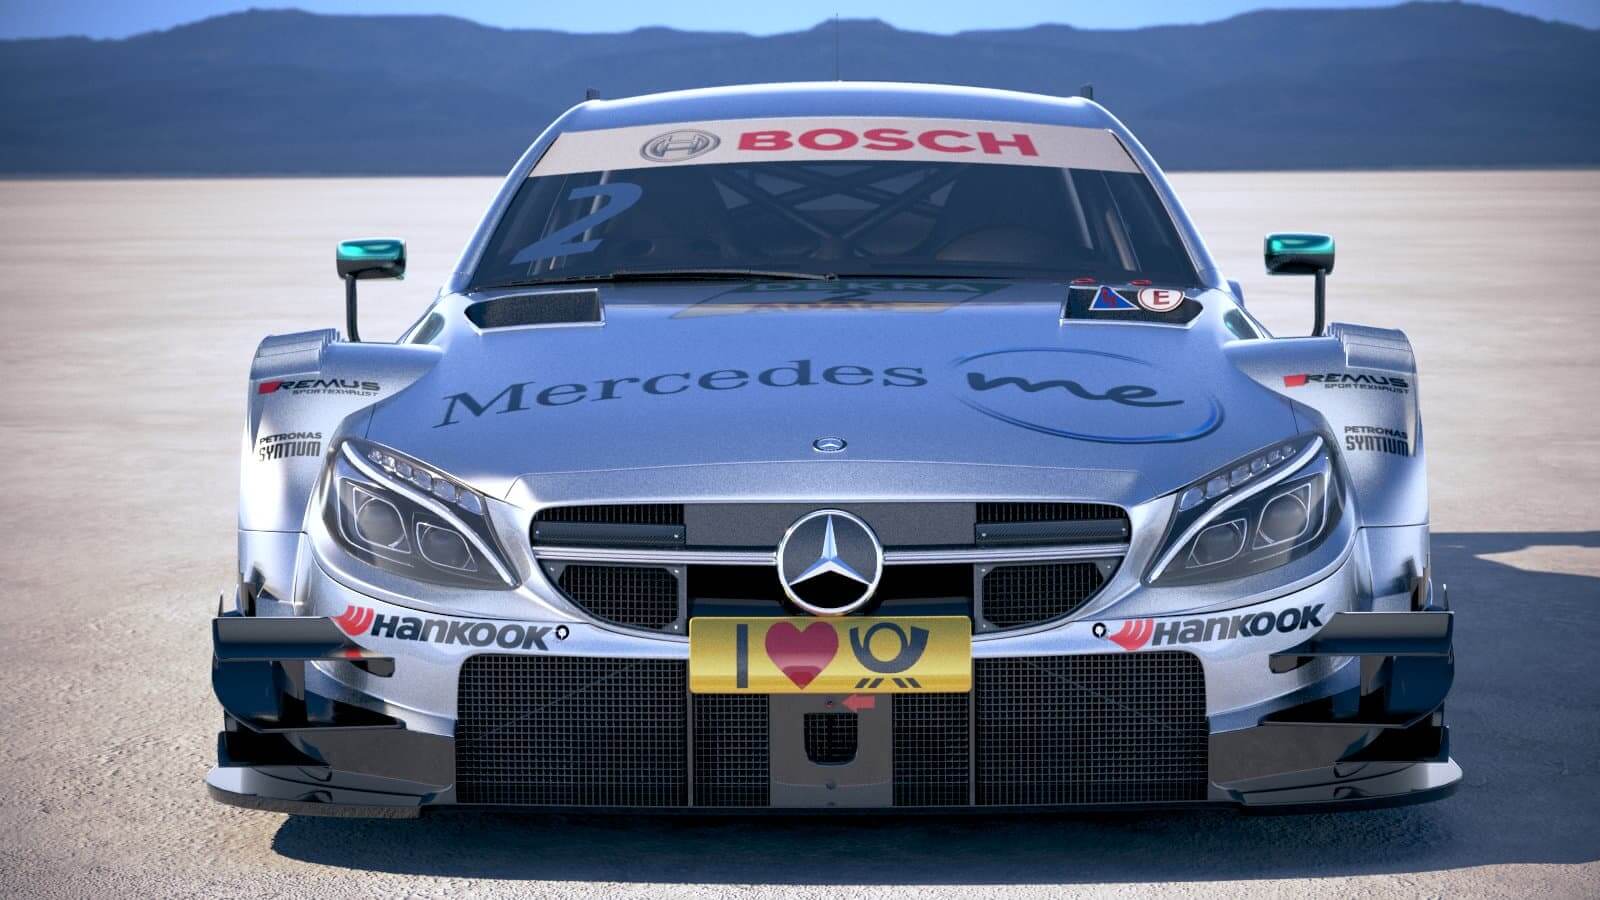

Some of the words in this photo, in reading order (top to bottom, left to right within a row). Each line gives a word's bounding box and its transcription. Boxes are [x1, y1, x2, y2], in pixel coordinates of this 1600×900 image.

[737, 128, 1039, 157] BOSCH
[510, 182, 642, 265] 2
[1153, 290, 1170, 305] E
[275, 379, 381, 391] REMUS
[1304, 373, 1409, 388] REMUS
[432, 359, 928, 428] Mercedes
[967, 372, 1185, 408] me
[1325, 383, 1409, 394] SPORTEXHAUST
[259, 431, 322, 444] PETRONAS
[1344, 425, 1409, 440] PETRONAS
